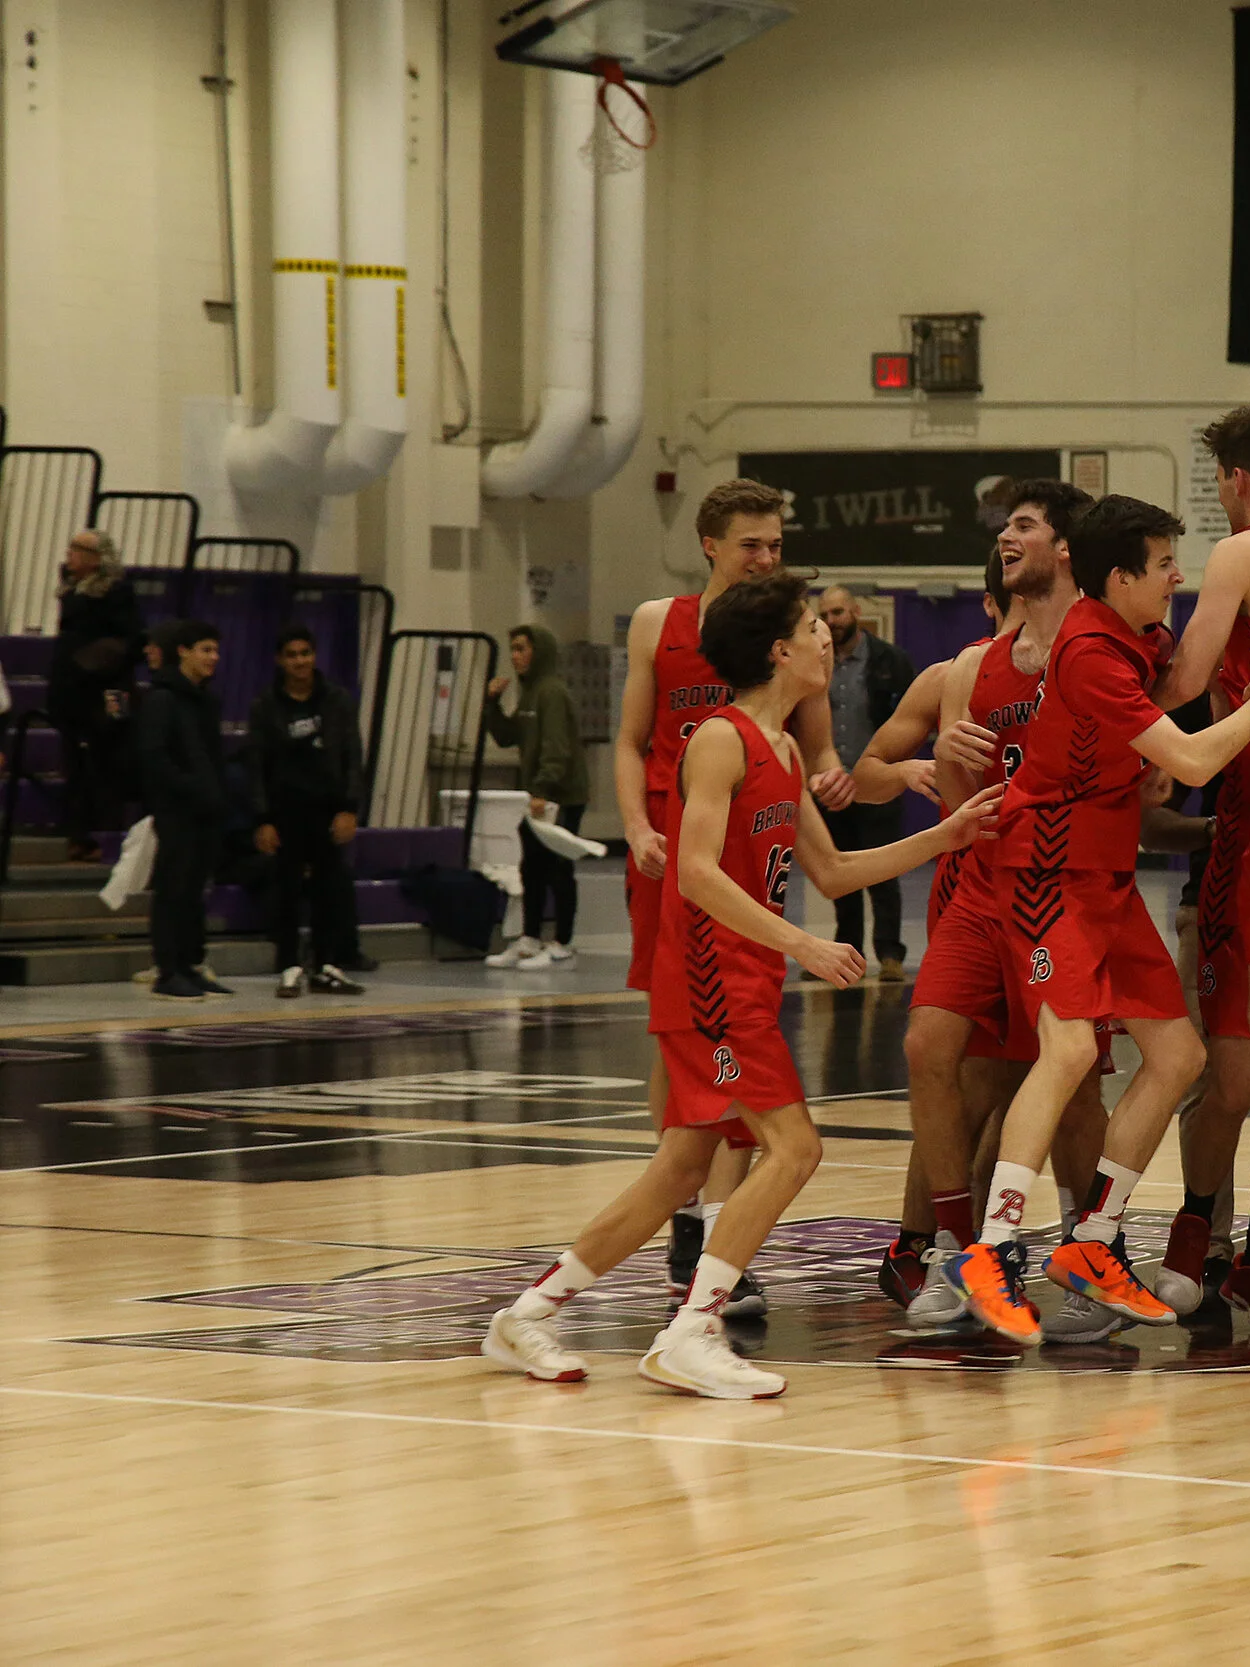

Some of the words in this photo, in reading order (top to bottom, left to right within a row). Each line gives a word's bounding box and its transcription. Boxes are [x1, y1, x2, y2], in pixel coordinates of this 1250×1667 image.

[812, 495, 831, 530] I
[1027, 946, 1054, 986] B
[712, 1045, 741, 1088] B
